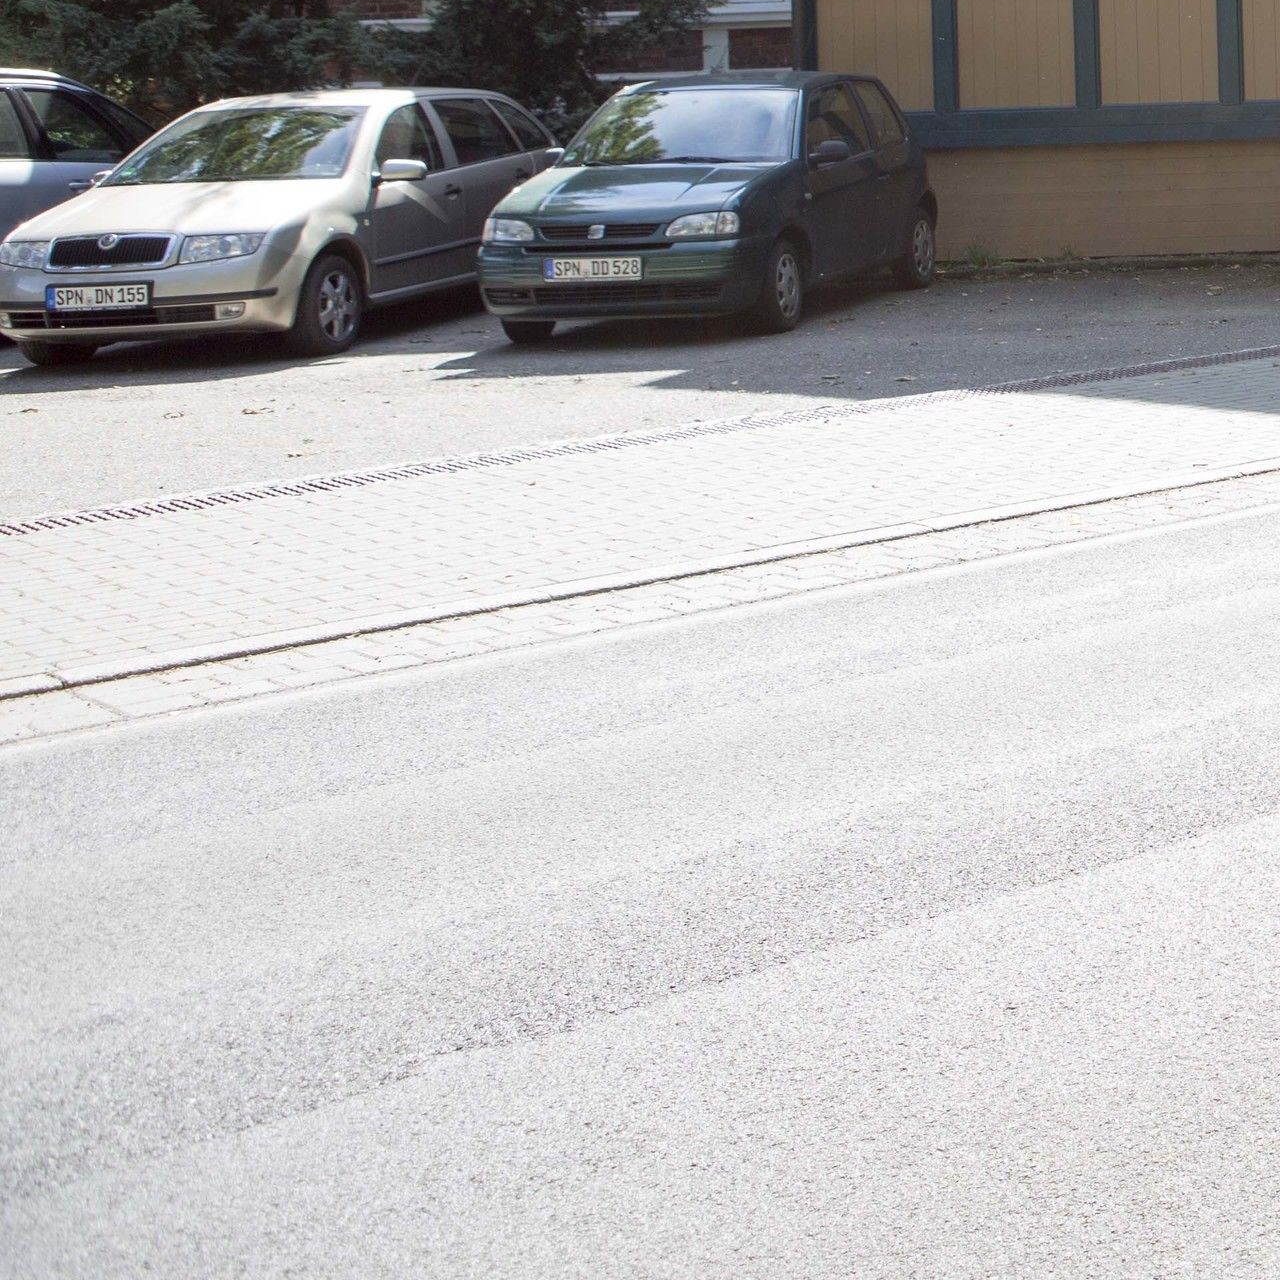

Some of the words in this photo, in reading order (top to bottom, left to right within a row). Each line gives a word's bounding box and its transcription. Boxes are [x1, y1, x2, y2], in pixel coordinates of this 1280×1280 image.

[554, 261, 581, 277] SPN
[592, 260, 609, 276] DD
[613, 259, 639, 275] 528
[56, 289, 84, 306] SPN
[95, 288, 115, 304] DN
[117, 287, 145, 303] 155
